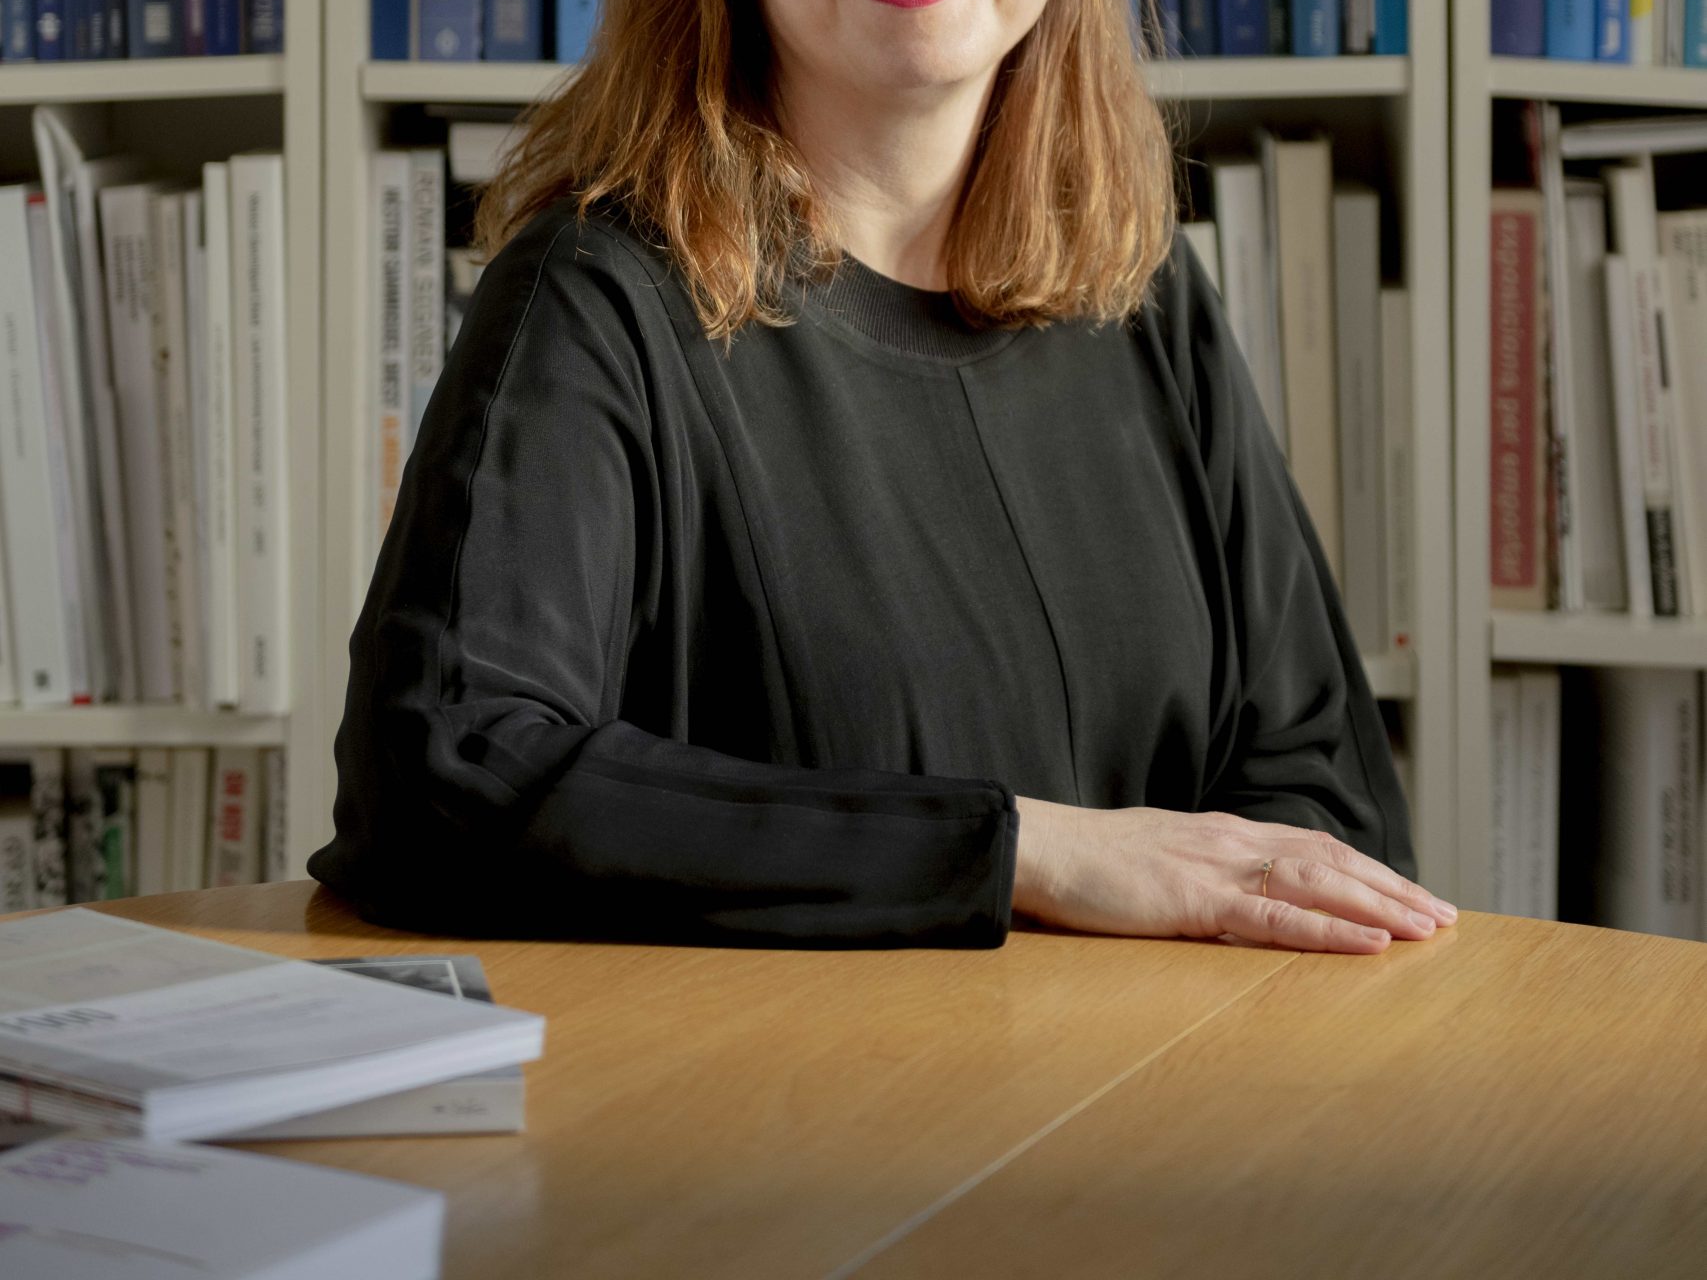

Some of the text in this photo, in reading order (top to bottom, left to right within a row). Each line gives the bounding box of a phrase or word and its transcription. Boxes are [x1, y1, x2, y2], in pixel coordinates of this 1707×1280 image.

[1495, 215, 1527, 582] exposicions per emportar
